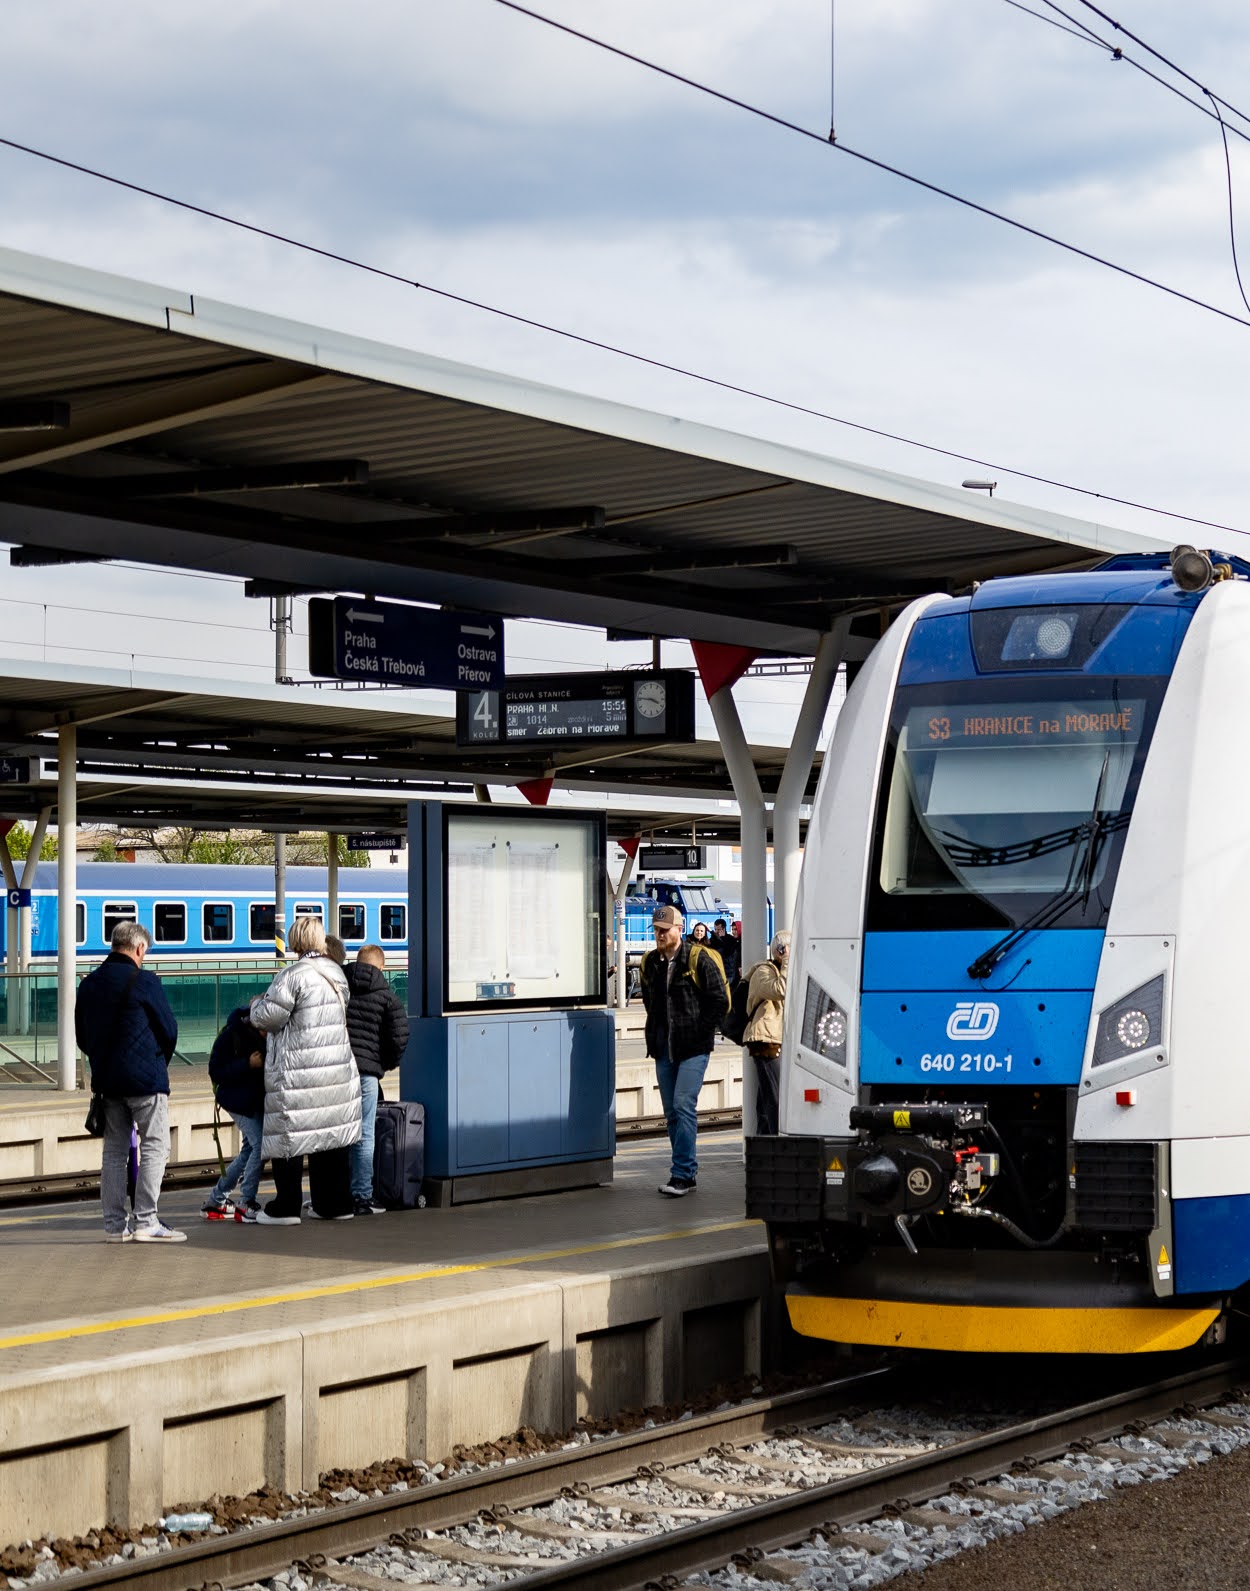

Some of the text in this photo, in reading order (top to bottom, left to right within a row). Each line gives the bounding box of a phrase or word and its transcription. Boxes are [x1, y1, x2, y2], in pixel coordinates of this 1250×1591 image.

[344, 630, 376, 649] Praha
[457, 644, 497, 662] Ostrava
[344, 650, 426, 677] Česká Třebová
[458, 665, 491, 683] Přerov
[506, 690, 571, 700] CÍLOVÁ STANICE
[507, 704, 534, 715] PRAHA
[602, 700, 626, 712] 15:51
[526, 715, 547, 726] 1014
[606, 713, 612, 722] 5
[612, 711, 627, 721] min
[928, 707, 1133, 740] S3 HRANICE na MORAVĚ
[473, 731, 499, 739] KOLEJ
[572, 725, 583, 734] na
[352, 838, 396, 848] 5. nástupiště
[686, 850, 698, 864] 10.
[10, 891, 20, 905] C
[31, 902, 38, 912] 2
[920, 1053, 1013, 1073] 640 210-1
